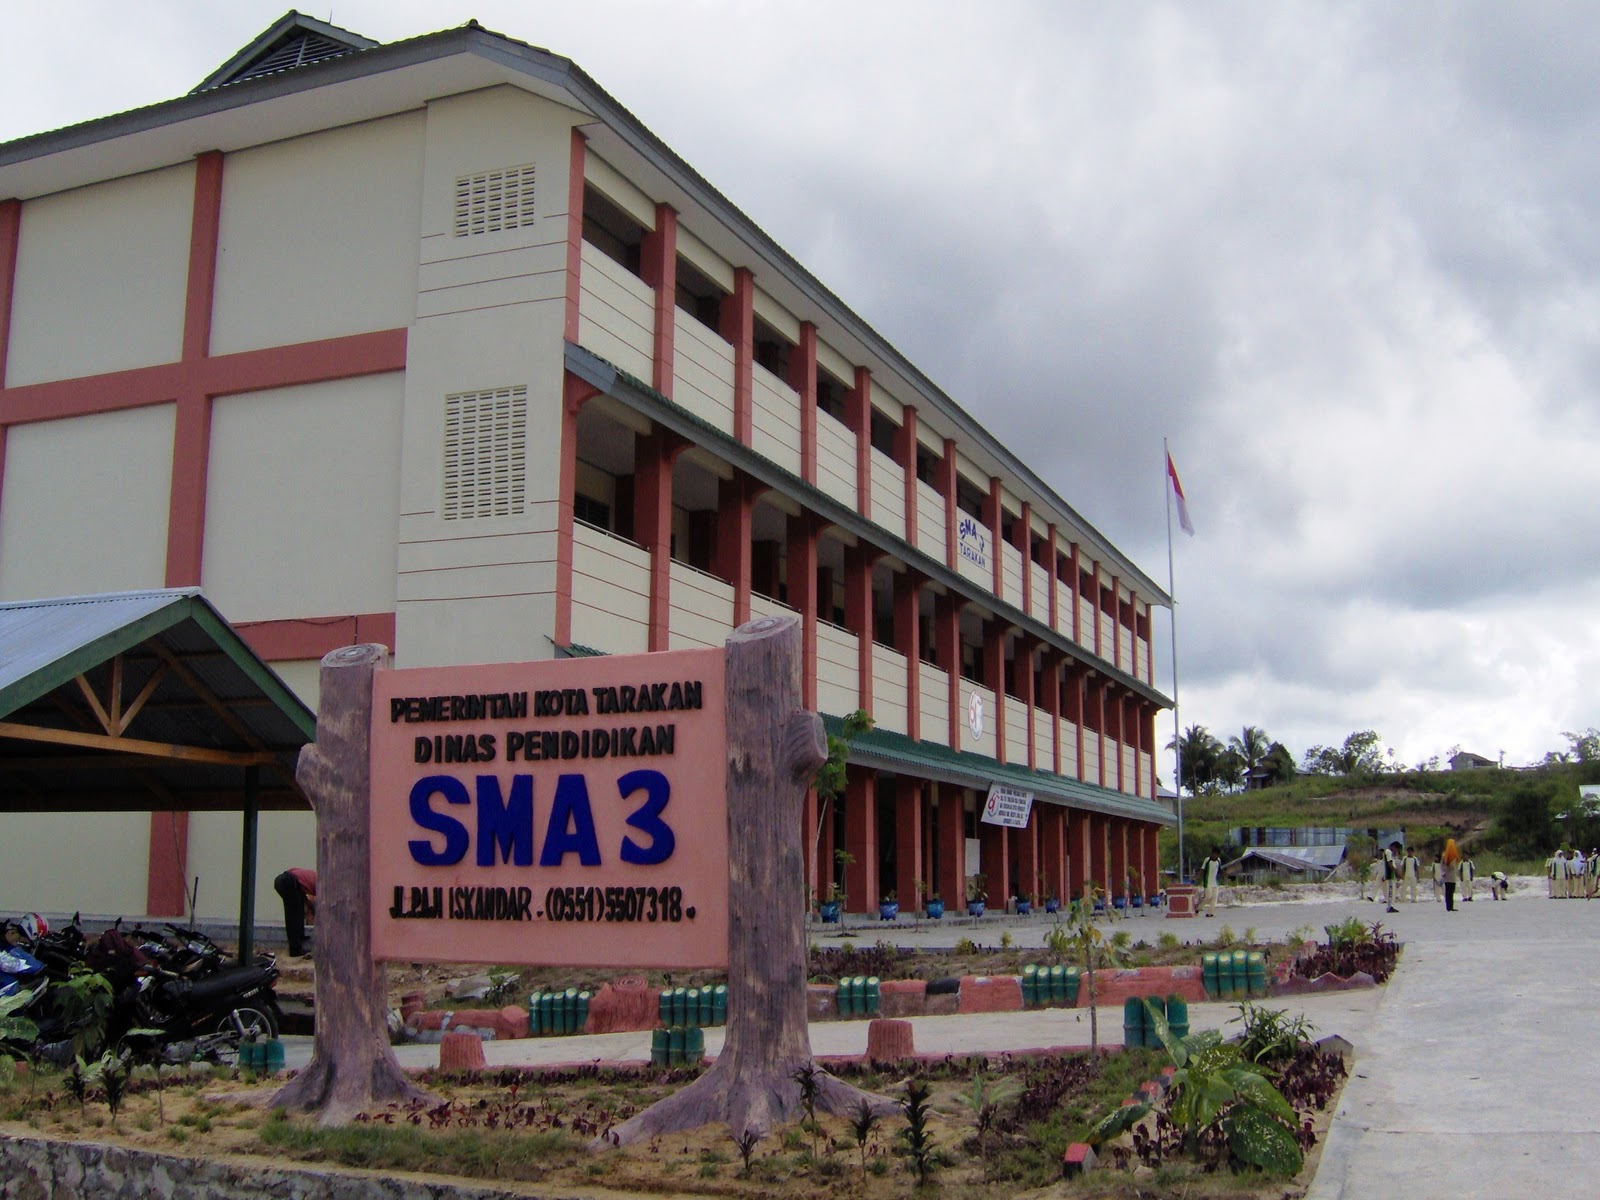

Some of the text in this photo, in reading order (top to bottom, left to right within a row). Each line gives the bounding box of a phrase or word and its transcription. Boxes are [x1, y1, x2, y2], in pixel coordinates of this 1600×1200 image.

[959, 519, 978, 540] SMA
[959, 541, 986, 568] TARAKAN
[391, 681, 702, 723] PEMERINTAH KOTA TARAKAN
[415, 724, 675, 763] DINAS PENDIDIKAN
[408, 770, 675, 867] SMA 3
